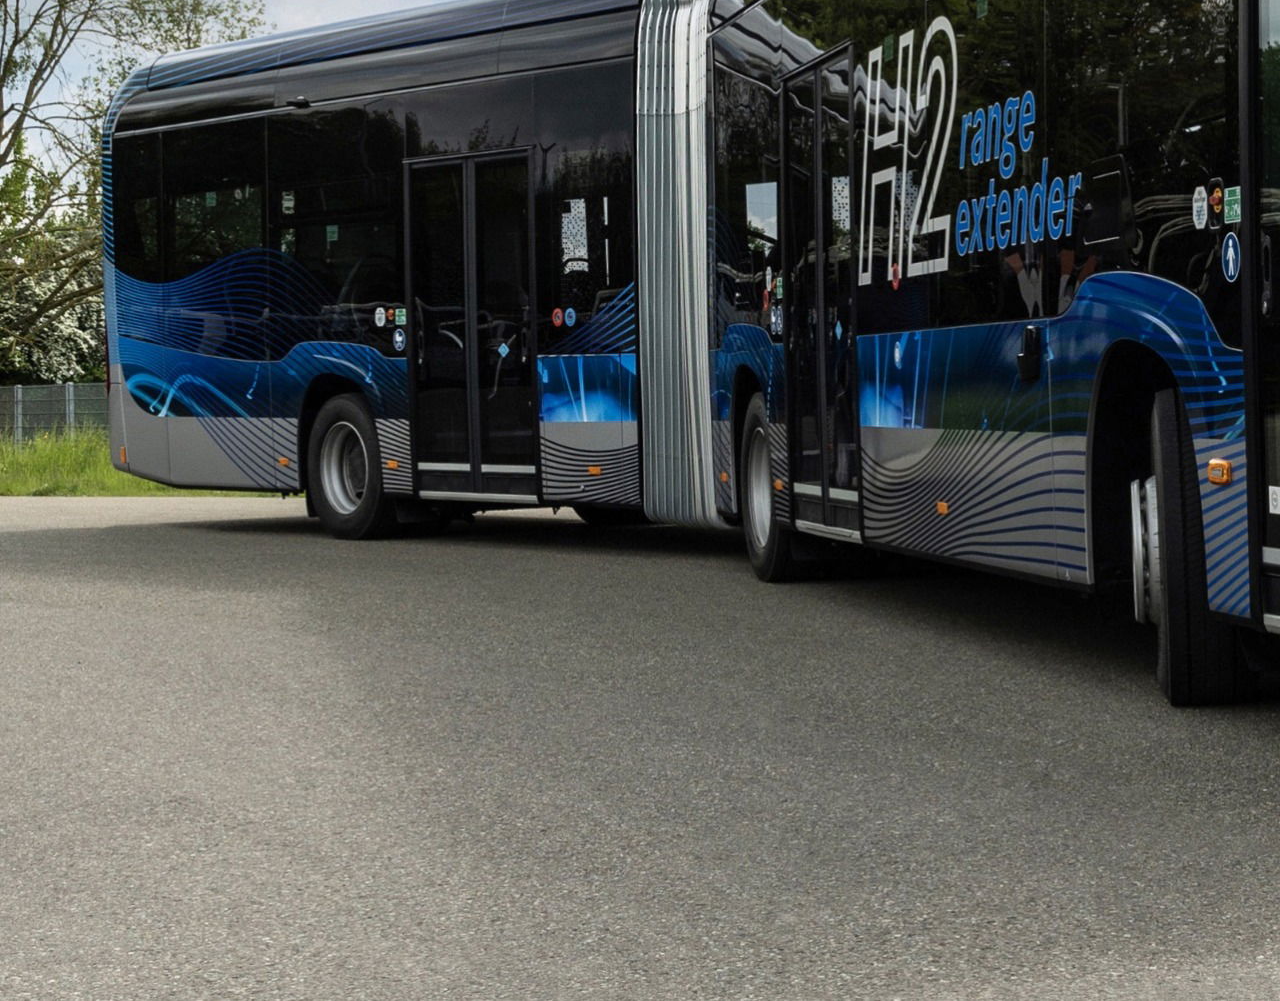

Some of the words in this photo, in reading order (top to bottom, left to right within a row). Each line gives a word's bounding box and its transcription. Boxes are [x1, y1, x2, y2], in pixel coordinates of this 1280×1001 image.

[858, 15, 958, 286] H2
[959, 90, 1036, 179] range
[955, 157, 1082, 256] extender
